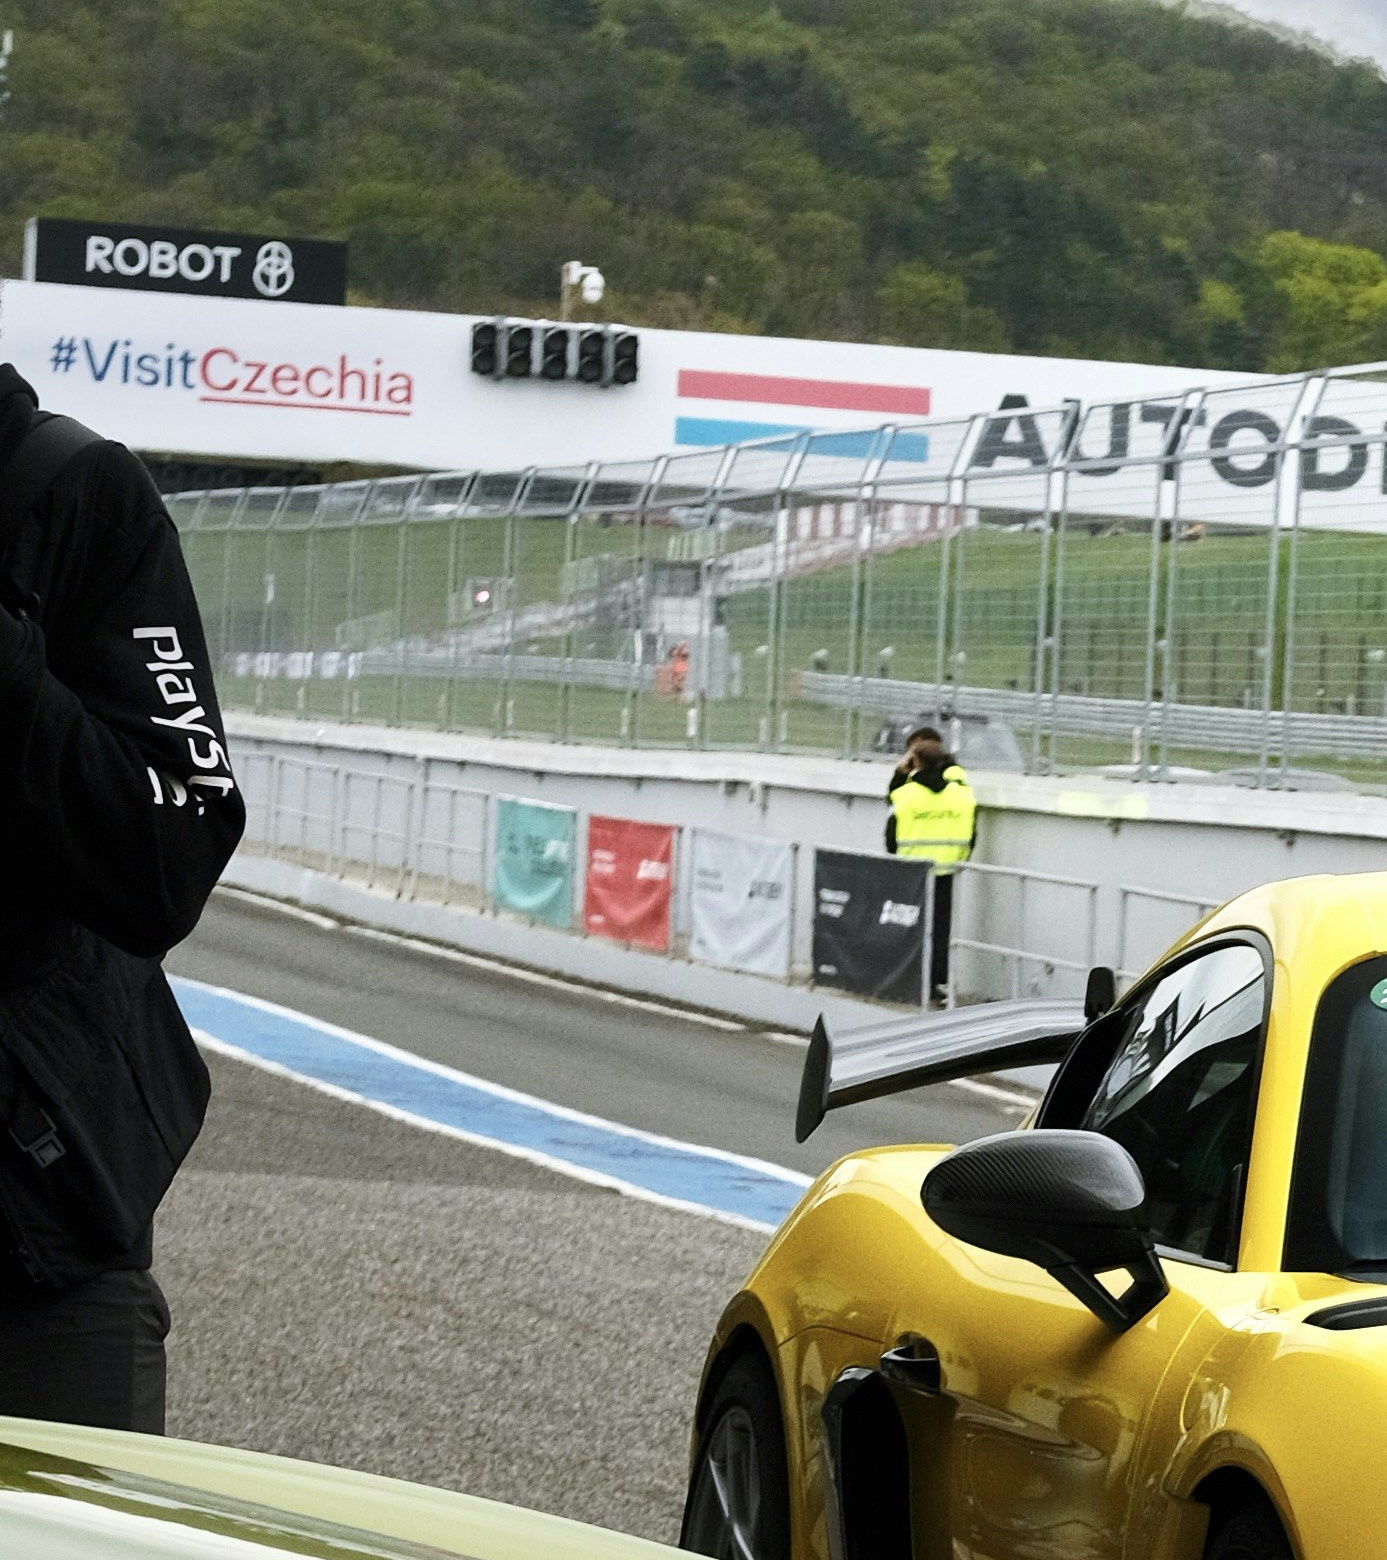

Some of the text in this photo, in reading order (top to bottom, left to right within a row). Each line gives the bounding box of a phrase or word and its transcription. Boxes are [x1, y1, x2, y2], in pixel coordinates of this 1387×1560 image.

[86, 235, 242, 283] ROBOT
[51, 335, 416, 405] #VisitCzechia
[133, 626, 234, 800] playst
